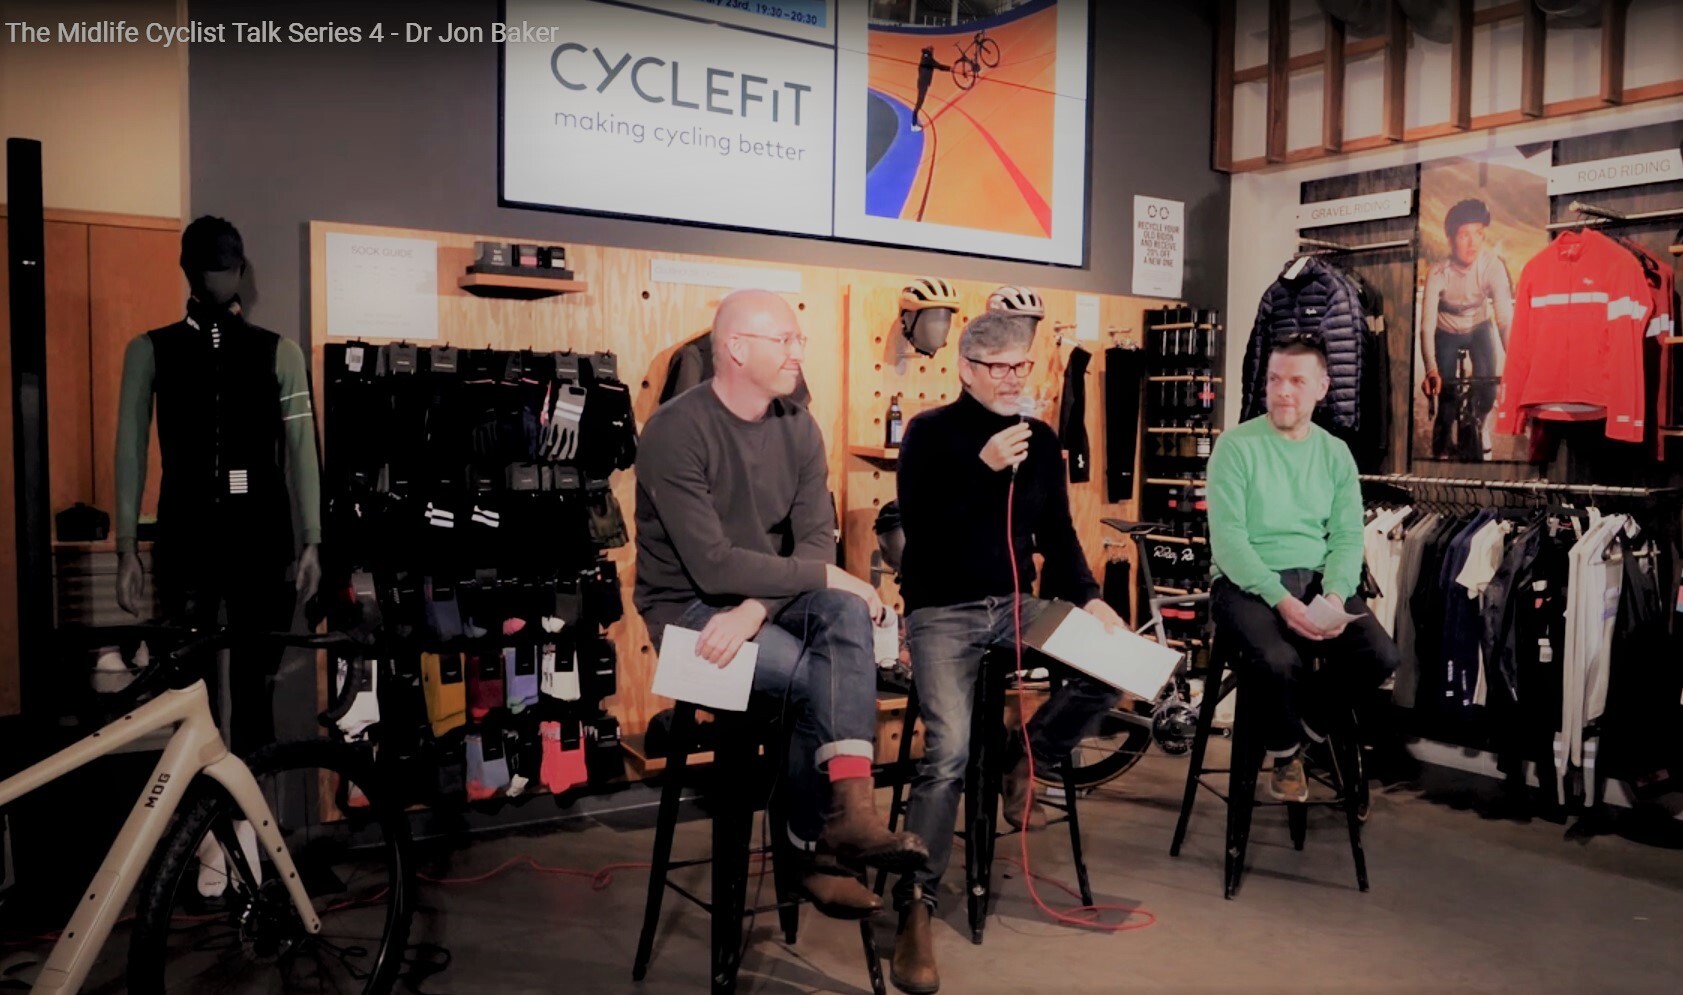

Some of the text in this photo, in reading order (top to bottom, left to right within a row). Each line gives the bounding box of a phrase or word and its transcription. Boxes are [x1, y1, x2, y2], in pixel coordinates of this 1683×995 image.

[554, 112, 806, 161] making cycling better
[1577, 158, 1671, 184] ROAD RIDING
[1311, 199, 1391, 220] GRAVEL RIDING
[1138, 220, 1163, 232] RECYCLE
[351, 245, 415, 259] SOCK GUIDE
[1141, 239, 1153, 248] AND
[144, 773, 171, 808] MOG
